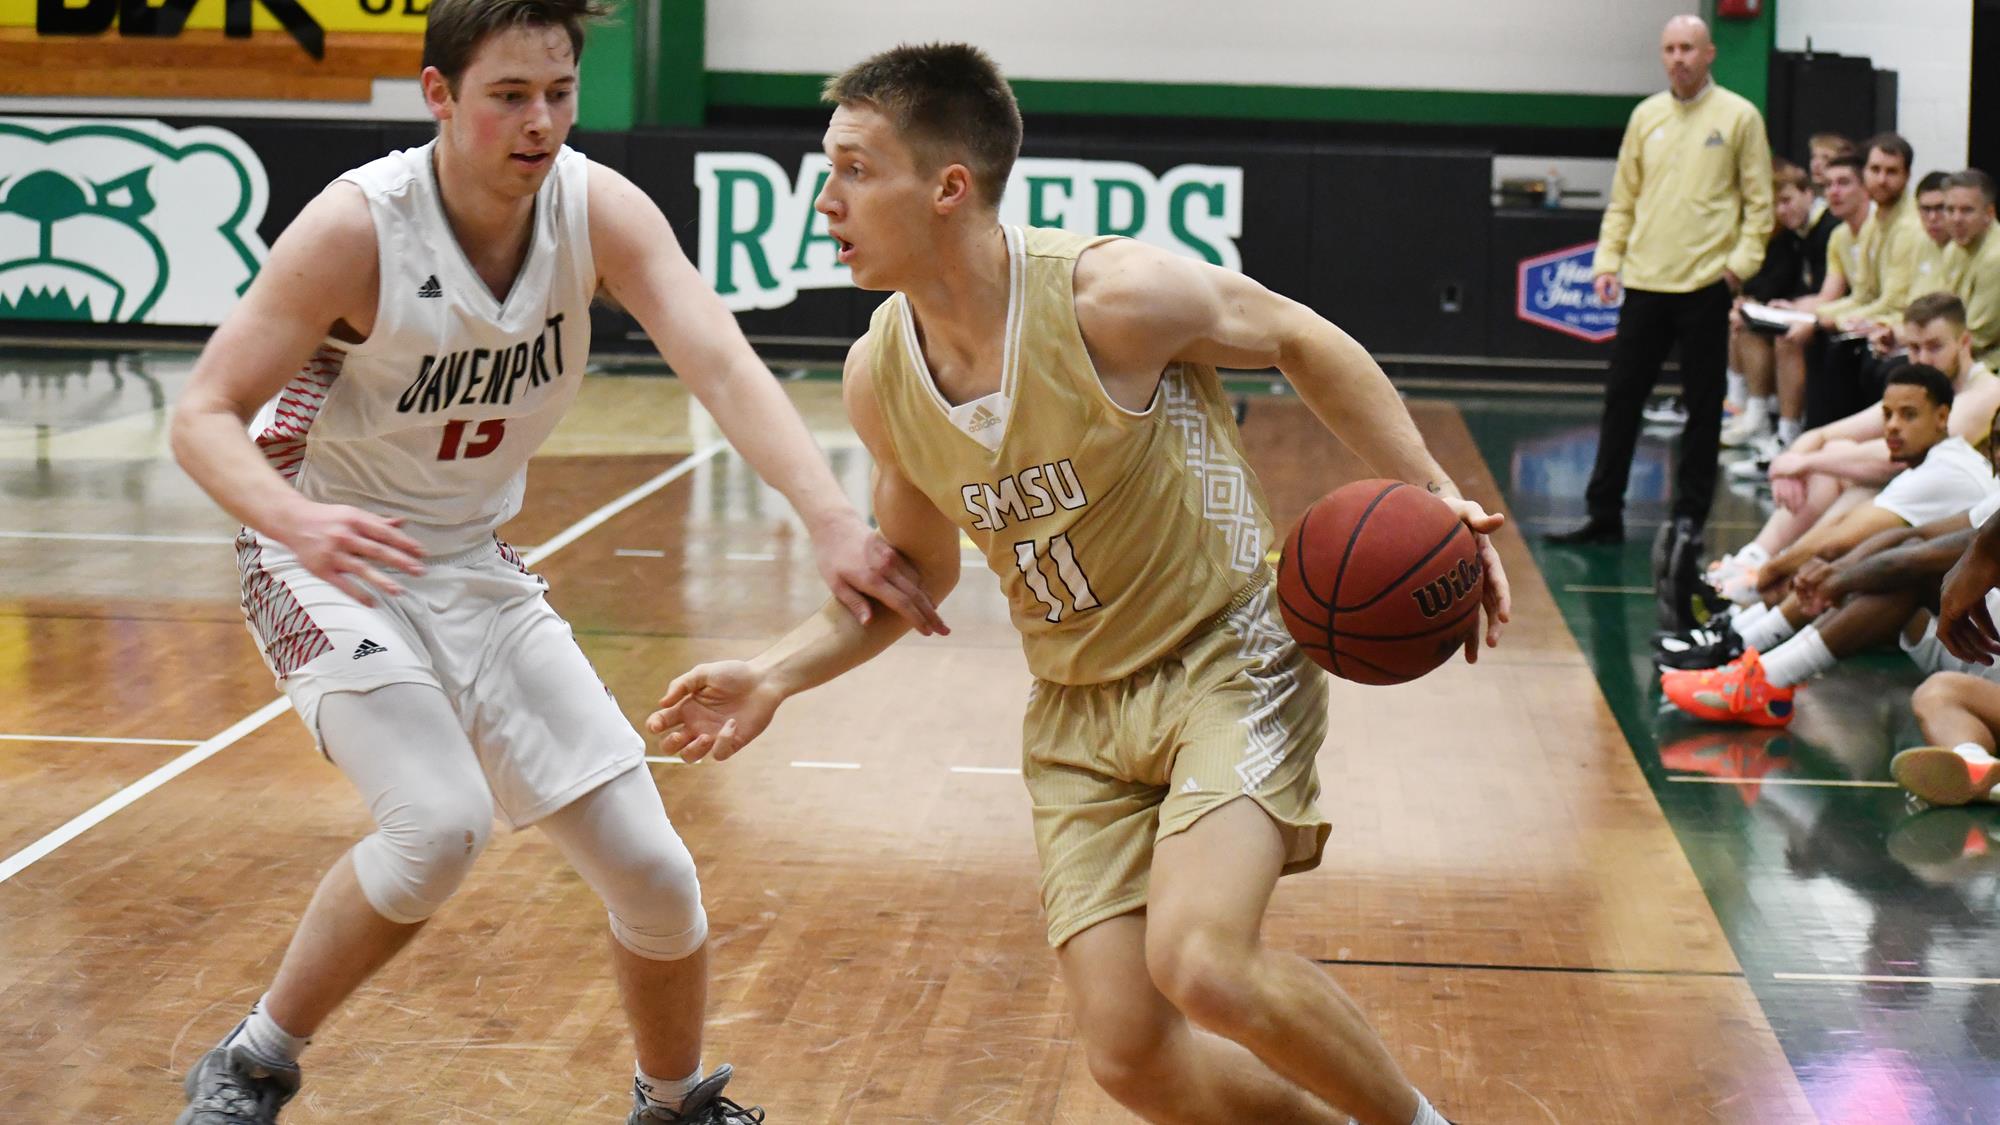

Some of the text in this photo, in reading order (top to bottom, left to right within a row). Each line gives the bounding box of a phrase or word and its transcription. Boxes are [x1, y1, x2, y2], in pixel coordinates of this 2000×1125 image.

[706, 162, 1230, 297] RAERS
[396, 312, 564, 413] DAVENPRT
[969, 416, 1001, 432] adidas
[961, 458, 1088, 531] SMSU
[1013, 531, 1101, 623] 11
[1410, 551, 1481, 619] Wils
[352, 647, 388, 660] adidas
